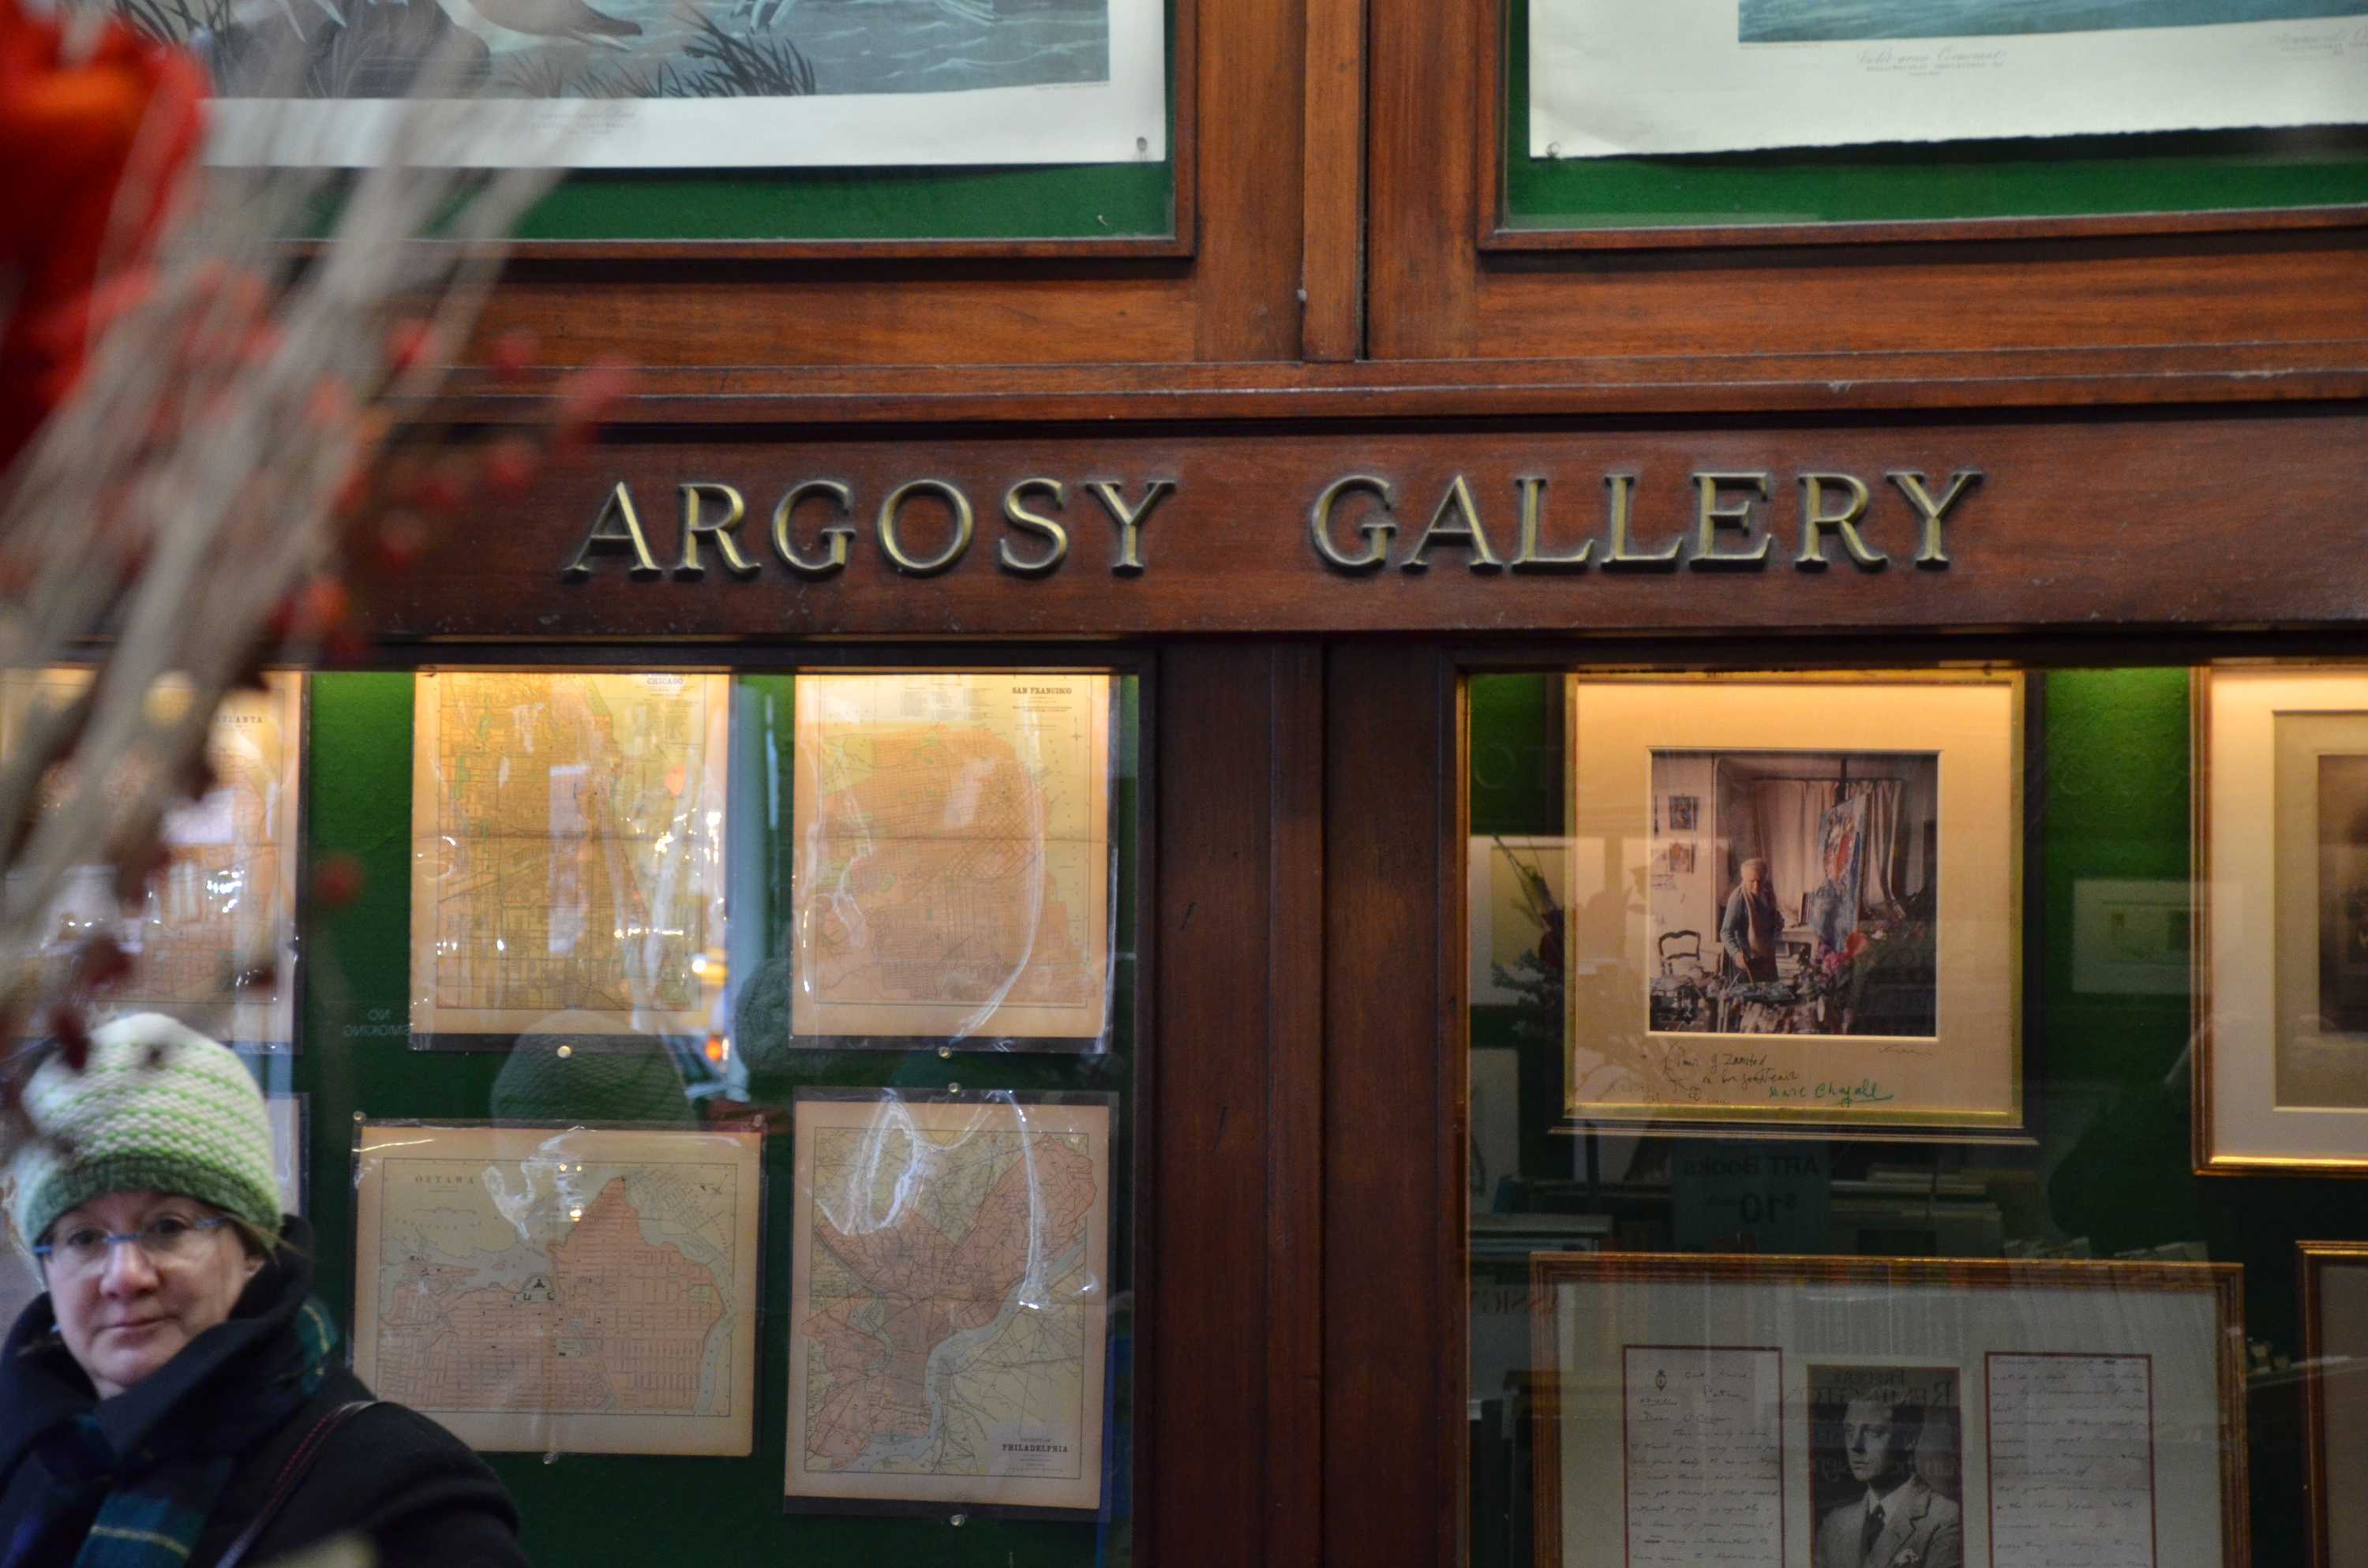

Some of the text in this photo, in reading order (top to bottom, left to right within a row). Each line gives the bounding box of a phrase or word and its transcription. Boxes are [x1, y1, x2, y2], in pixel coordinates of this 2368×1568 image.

[560, 471, 1983, 579] ARGOSY GALLERY
[414, 1174, 474, 1184] OTTAWA
[1002, 1443, 1068, 1453] PHILADELPHIA
